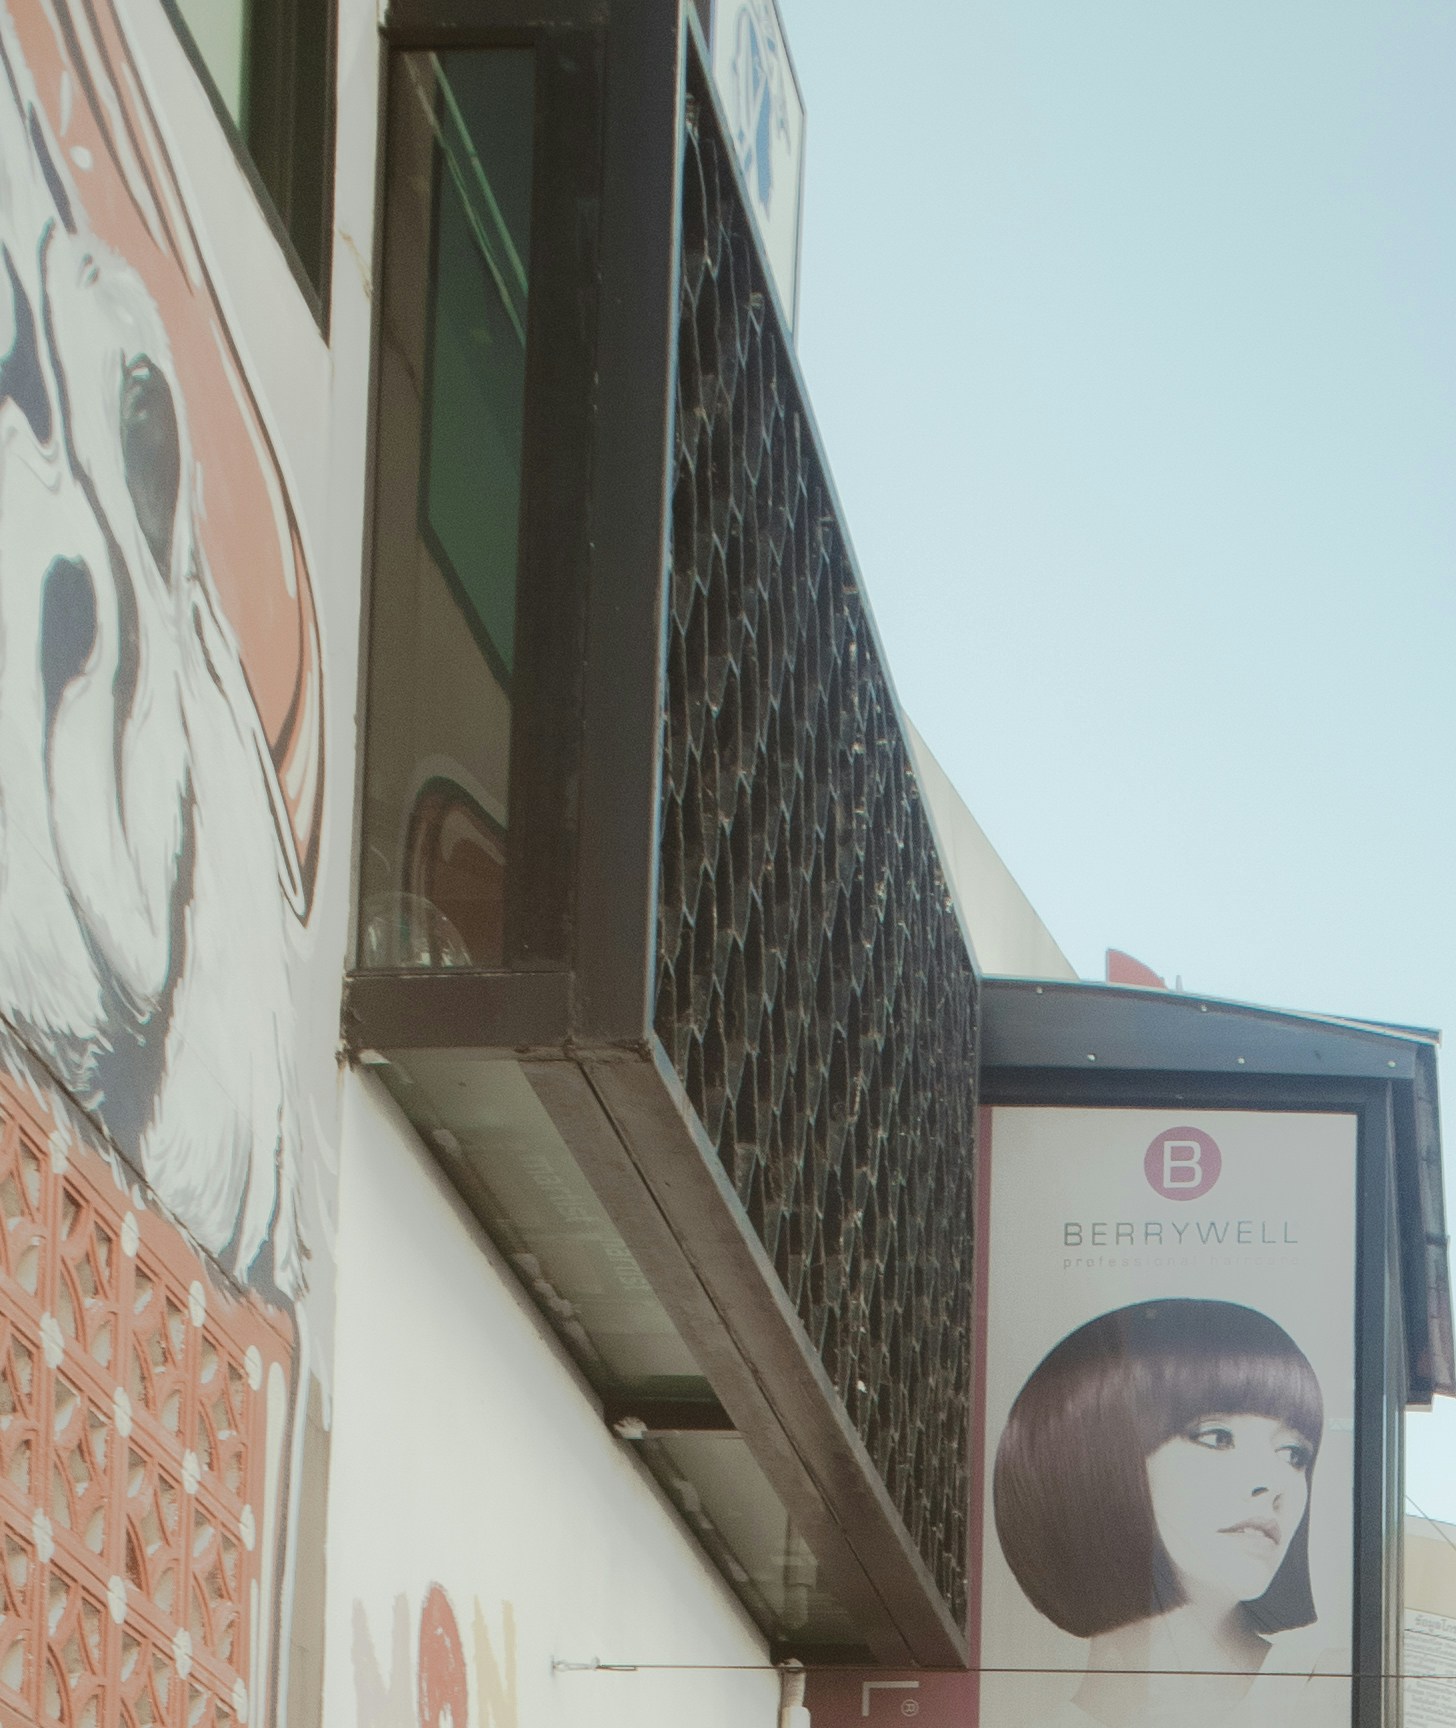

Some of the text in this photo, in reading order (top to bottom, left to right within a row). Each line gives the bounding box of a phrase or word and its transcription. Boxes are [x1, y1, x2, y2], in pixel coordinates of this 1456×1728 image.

[1162, 1139, 1203, 1189] B
[1063, 1220, 1299, 1247] BERRYWELL
[1063, 1254, 1200, 1268] professional
